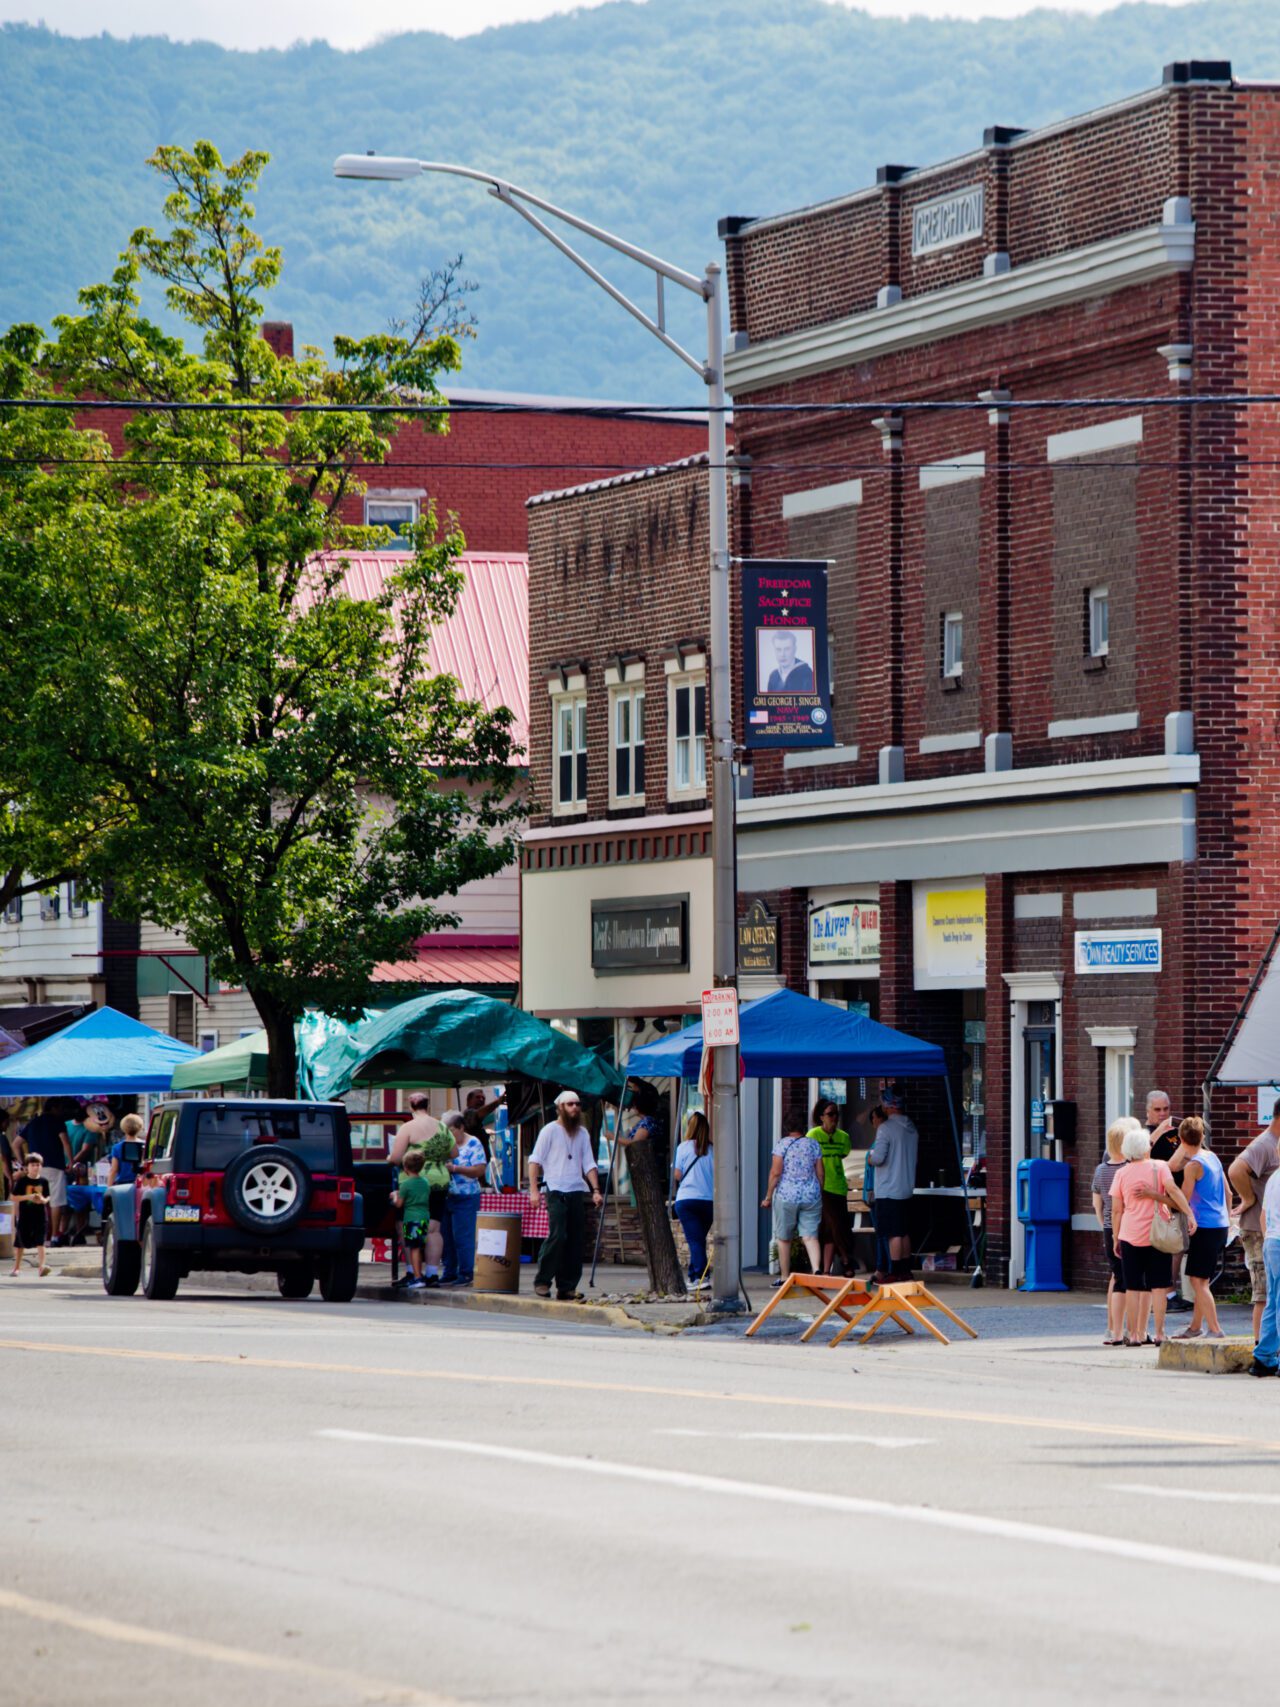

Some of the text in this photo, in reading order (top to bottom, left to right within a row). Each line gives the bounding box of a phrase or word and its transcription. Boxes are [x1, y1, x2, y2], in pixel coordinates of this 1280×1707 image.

[917, 193, 982, 247] CREIGHTON
[758, 577, 811, 589] FREEDOM
[758, 596, 812, 608] SACRIFICE
[763, 615, 807, 625] HONOR
[767, 697, 792, 706] GEORGE
[799, 697, 821, 706] SINGER
[814, 918, 823, 938] The
[824, 911, 850, 937] River
[646, 917, 680, 958] Emporium
[739, 926, 775, 945] LAW OFFICES
[1102, 944, 1125, 963] REALTY
[1125, 943, 1158, 962] SERVICES
[711, 992, 735, 1001] PARKING
[724, 1008, 733, 1016] AM
[726, 1028, 734, 1037] AM
